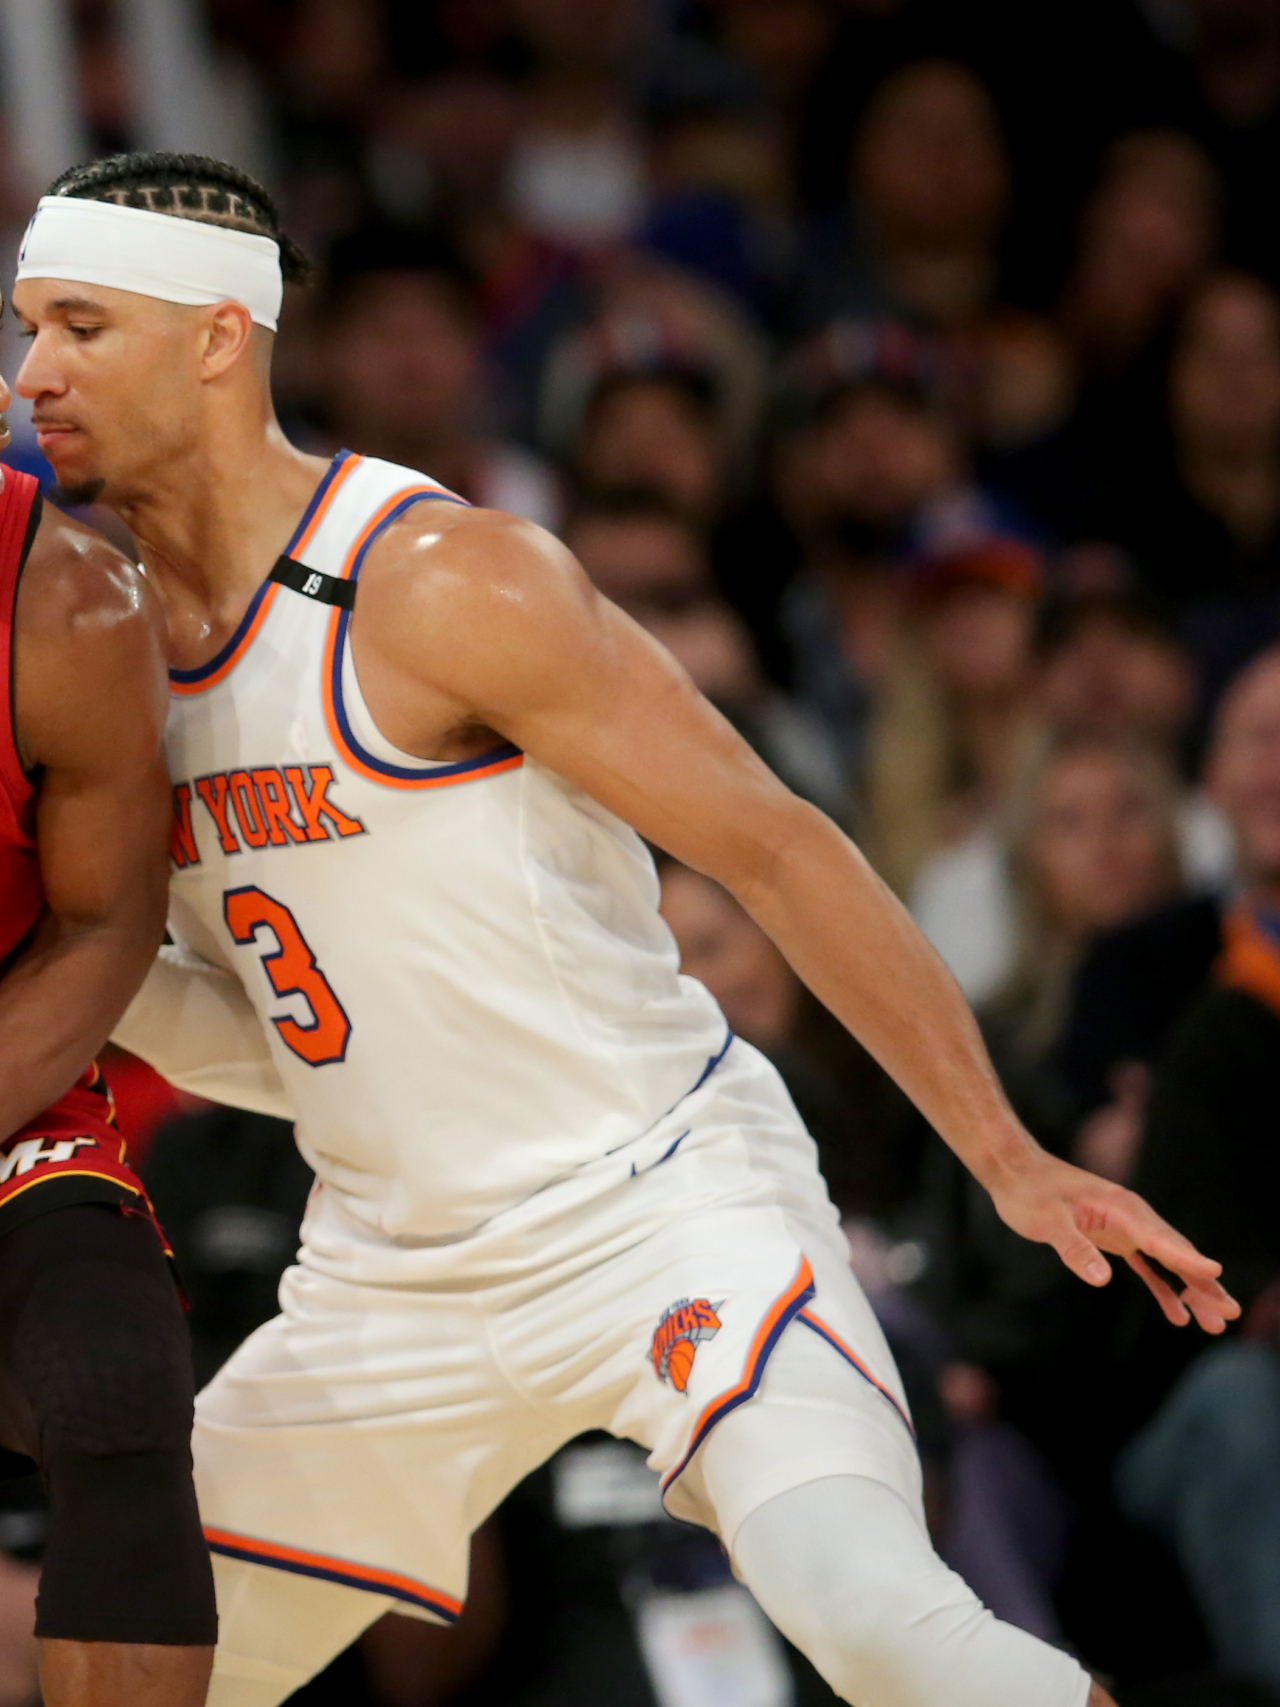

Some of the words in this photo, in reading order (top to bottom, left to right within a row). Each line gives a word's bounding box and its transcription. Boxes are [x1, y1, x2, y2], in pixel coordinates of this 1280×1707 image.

[301, 573, 323, 595] 19
[194, 764, 366, 855] YORK
[222, 884, 353, 1068] 3
